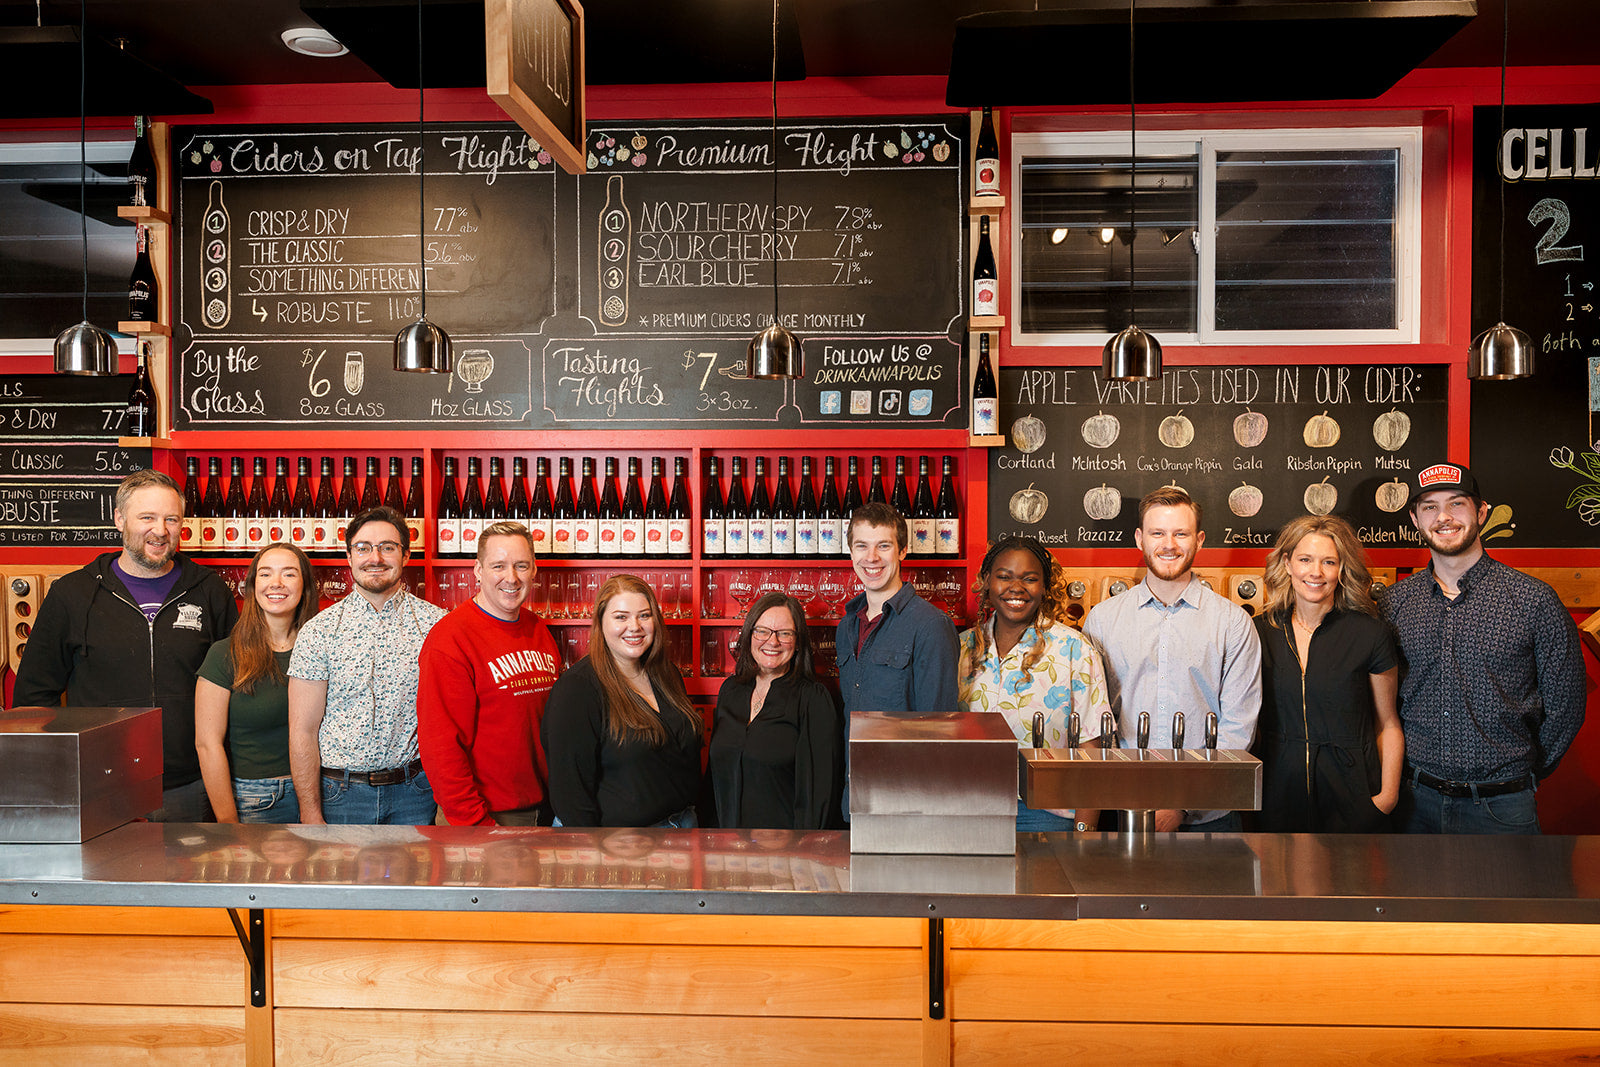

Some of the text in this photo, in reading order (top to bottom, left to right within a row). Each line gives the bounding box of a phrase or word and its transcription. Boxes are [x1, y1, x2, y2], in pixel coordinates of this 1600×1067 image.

[228, 139, 328, 173] Ciders
[334, 147, 371, 171] on
[441, 134, 529, 186] Flight
[655, 131, 879, 177] Premium Flight
[1500, 127, 1600, 180] CELL
[248, 209, 297, 237] CRISP
[314, 207, 350, 235] DRY
[639, 201, 769, 232] NORTHERN
[771, 204, 813, 231] SPY
[1527, 197, 1585, 265] 2
[248, 242, 280, 264] THE
[285, 240, 345, 264] CLASSIC
[637, 233, 705, 262] SOUR
[708, 232, 798, 261] CHERRY
[248, 266, 435, 293] SOMETHING DIFFERENT
[638, 262, 695, 286] EARL
[700, 261, 760, 286] BLUE
[277, 300, 373, 324] ROBUSTE
[652, 313, 866, 329] PREMIUM CIDERS CHANGE MONTHLY
[1565, 302, 1576, 321] 2
[1542, 330, 1582, 353] Both
[552, 346, 653, 386] Tasting
[823, 345, 885, 367] FOLLOW
[890, 344, 910, 362] US
[191, 345, 262, 391] By the
[813, 364, 943, 386] DRINKANNAPOLIS
[558, 375, 671, 418] Flights
[1017, 370, 1077, 405] APPLE
[1211, 367, 1260, 405] USED
[1275, 366, 1299, 404] IN
[1315, 366, 1352, 405] OUR
[1364, 366, 1422, 404] CIDER:
[190, 386, 267, 420] Glass
[335, 397, 386, 418] GLASS
[462, 397, 514, 417] GLASS
[28, 408, 58, 430] DRY
[12, 449, 64, 470] CLASSIC
[997, 452, 1056, 470] Cortland
[1071, 453, 1127, 471] McIntosh
[1160, 456, 1194, 475] Orange
[1194, 456, 1223, 475] Pippin
[1232, 455, 1264, 471] Gala
[1286, 455, 1326, 471] Ribston
[1326, 456, 1363, 474] Pippin
[1375, 456, 1411, 471] Mutsu
[1422, 467, 1460, 480] ANNAPOLIS
[0, 489, 96, 501] THING DIFFERENT
[12, 531, 44, 541] LISTED
[50, 530, 68, 541] FOR
[1038, 528, 1069, 544] Russet
[1077, 526, 1123, 543] Pazazz
[1223, 527, 1272, 545] Zestar
[1356, 526, 1397, 543] Golden
[487, 650, 556, 684] ANNAPOLIS
